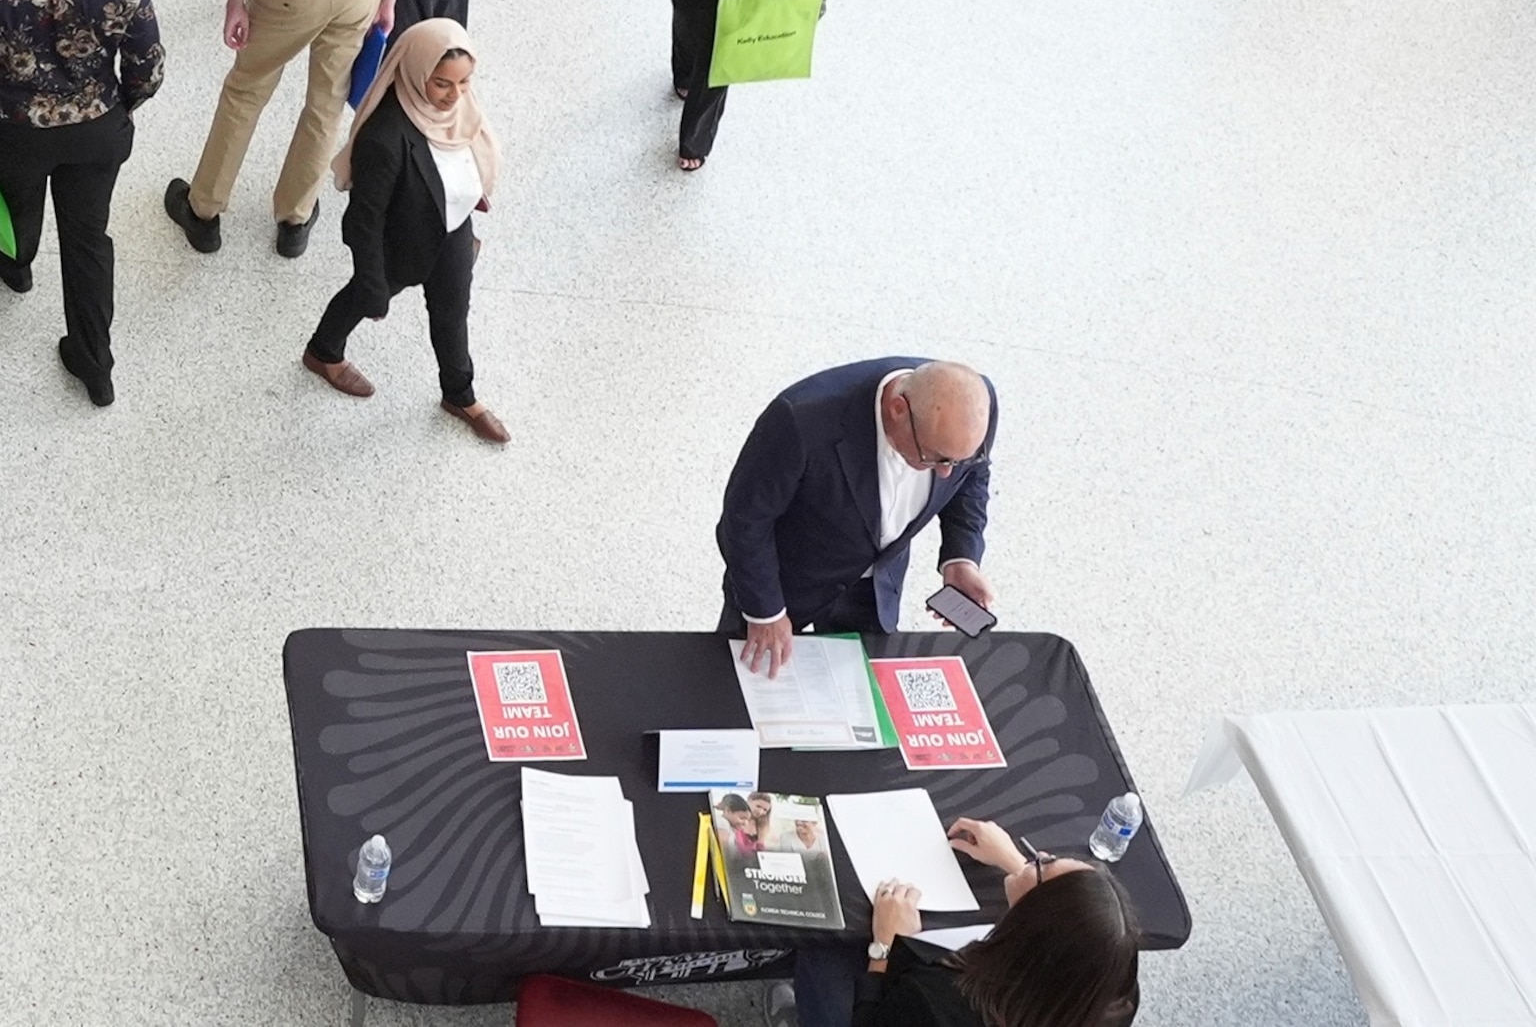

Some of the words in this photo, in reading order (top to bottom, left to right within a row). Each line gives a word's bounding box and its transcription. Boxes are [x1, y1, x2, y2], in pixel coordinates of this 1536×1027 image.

[502, 705, 552, 720] TEAM!
[912, 713, 965, 727] TEAM!
[493, 726, 529, 739] OUR
[532, 722, 571, 738] JOIN
[905, 734, 944, 748] OUR
[946, 729, 986, 747] JOIN
[754, 880, 803, 894] Together
